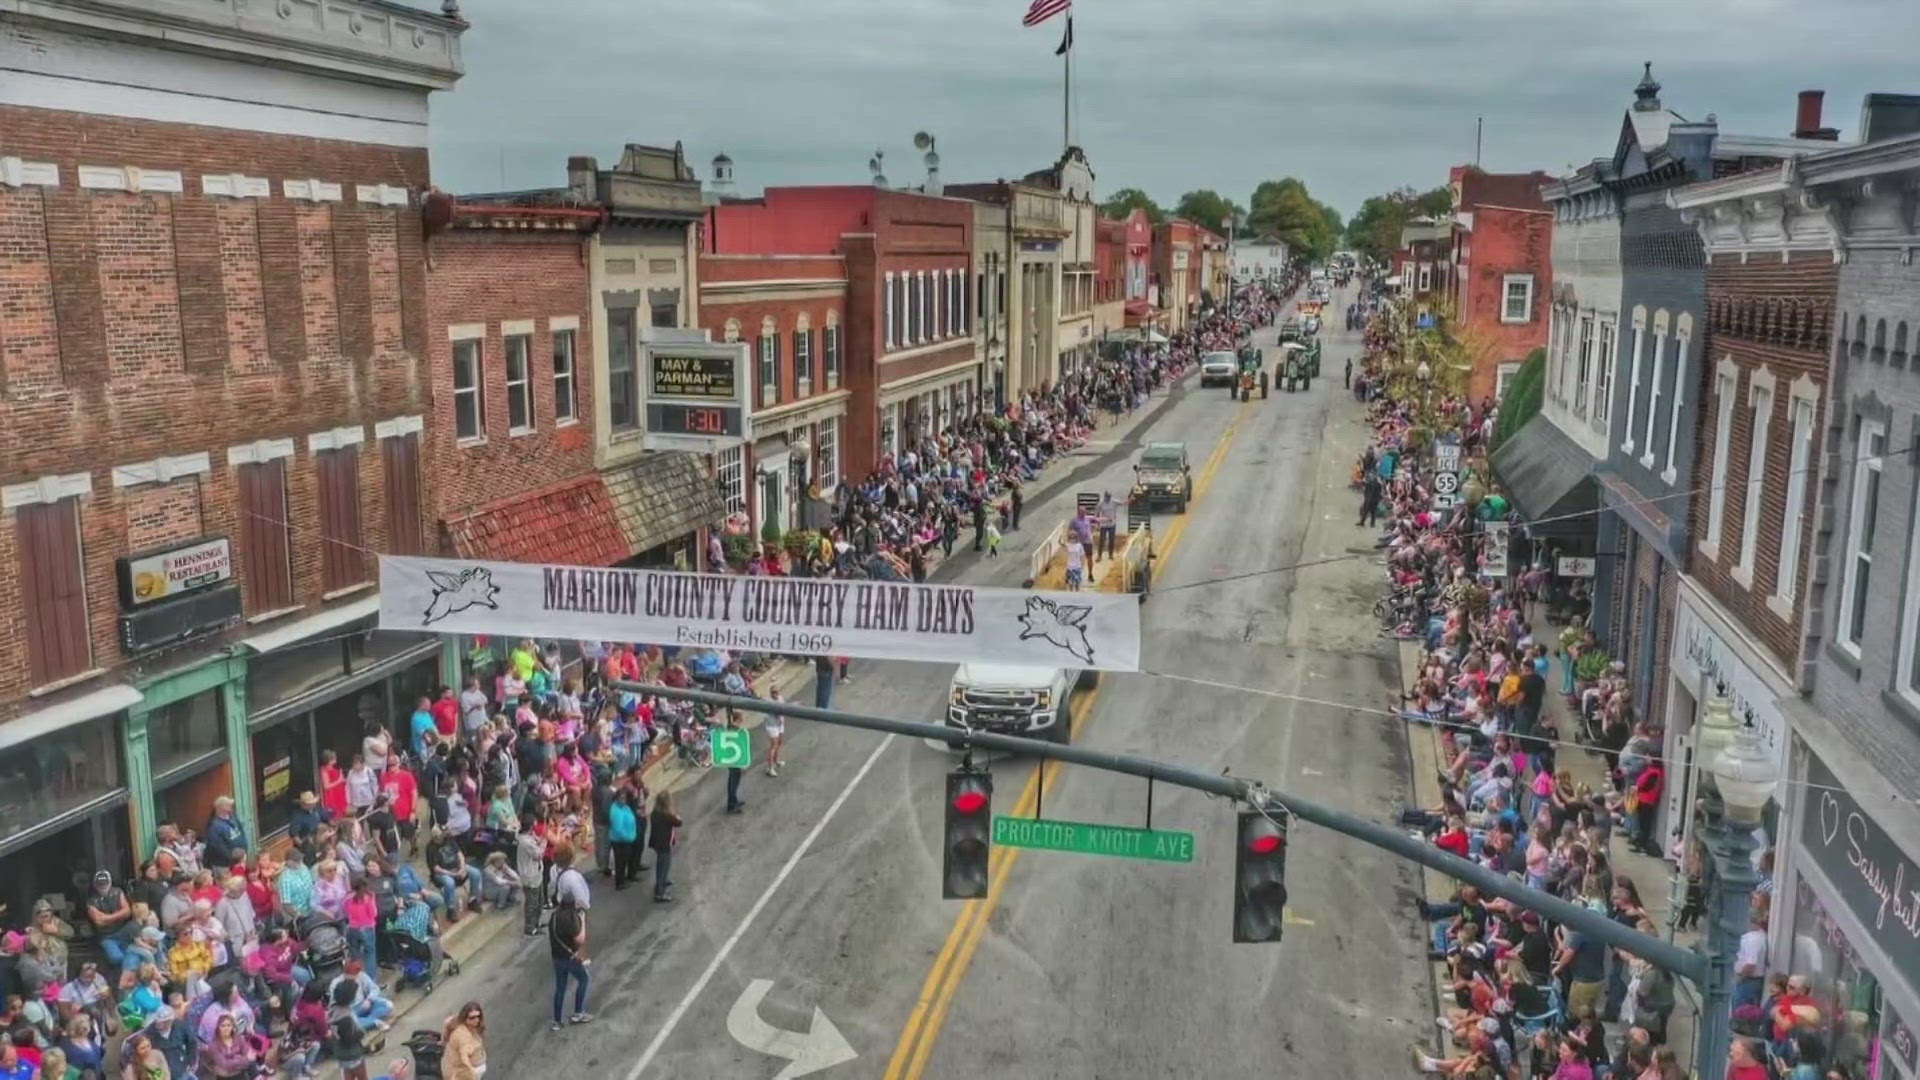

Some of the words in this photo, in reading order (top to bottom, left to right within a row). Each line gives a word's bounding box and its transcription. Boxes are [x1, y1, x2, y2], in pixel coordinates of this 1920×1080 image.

[656, 371, 712, 384] PARMAN
[661, 359, 689, 371] MAY
[692, 360, 702, 371] &
[686, 408, 721, 431] 1:30
[1439, 477, 1455, 490] 55
[543, 567, 637, 616] MARION
[645, 573, 736, 621] COUNTY
[743, 578, 849, 628] COUNTRY
[854, 584, 909, 632] HAM
[916, 587, 974, 635] DAYS
[676, 625, 782, 650] Established
[789, 632, 832, 651] 1969
[721, 731, 742, 764] 5
[996, 820, 1074, 847] PROCTOR
[1089, 829, 1142, 854] KNOTT
[1155, 835, 1190, 859] AVE
[1846, 812, 1891, 930] Sassy
